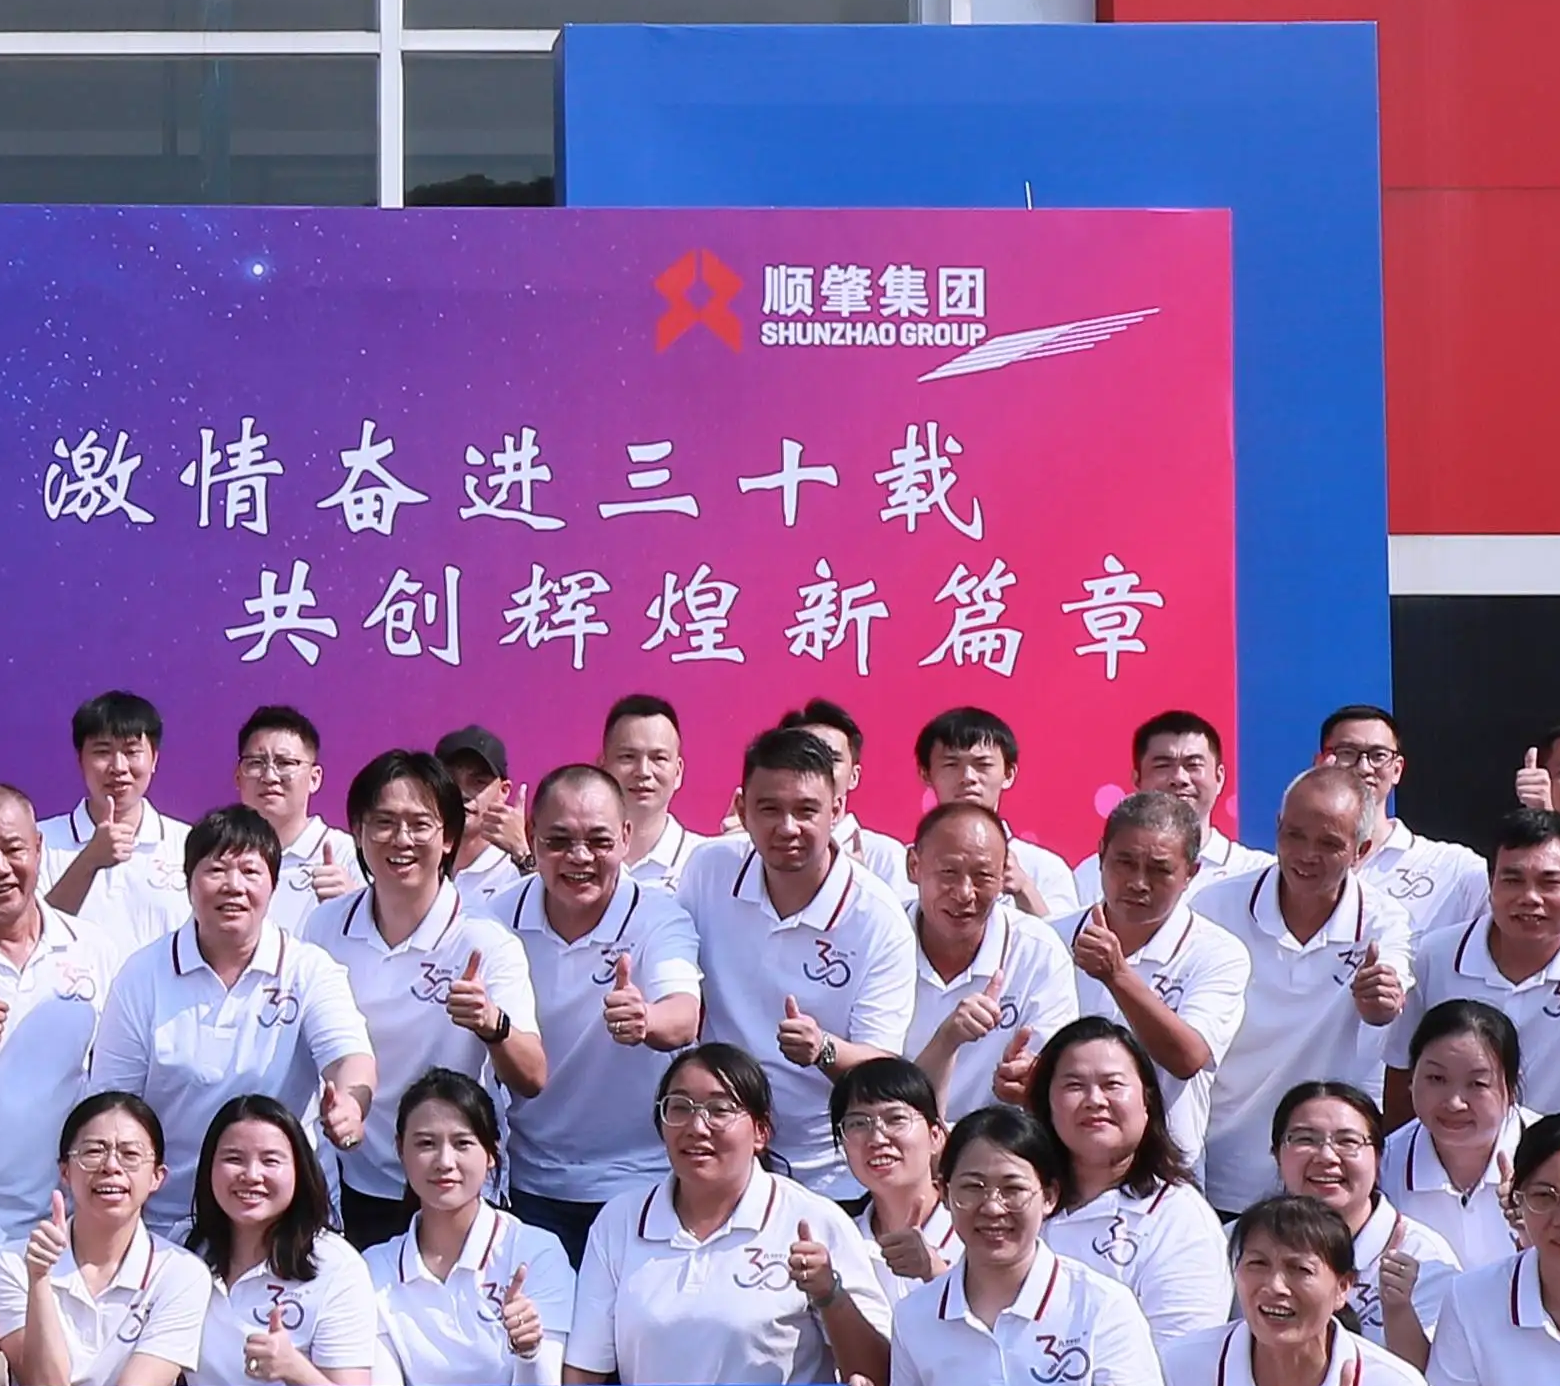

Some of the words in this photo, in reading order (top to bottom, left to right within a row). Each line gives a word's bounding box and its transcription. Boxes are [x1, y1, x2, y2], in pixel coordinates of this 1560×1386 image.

[762, 263, 986, 318] 顺肇集团
[760, 321, 895, 347] SHUNZHAO
[898, 321, 987, 347] GROUP
[41, 418, 985, 539] 激情奋进三十载
[225, 553, 1165, 680] 共创辉煌新篇章
[802, 939, 851, 989] 30
[257, 987, 299, 1028] 30
[1031, 1335, 1090, 1385] 30
